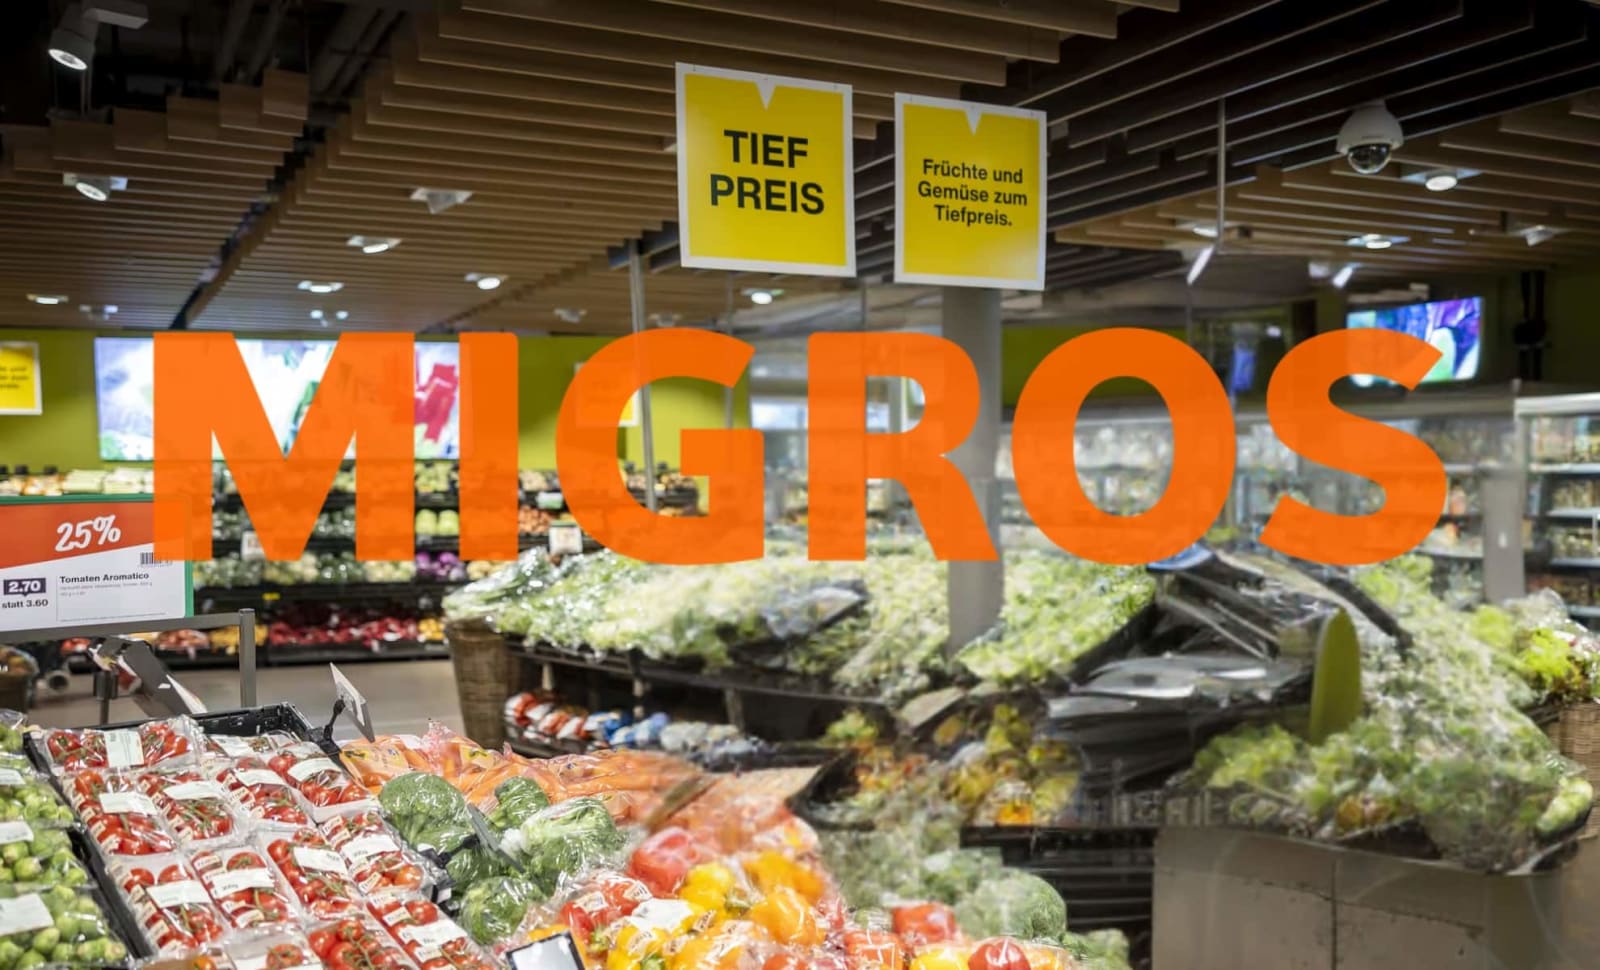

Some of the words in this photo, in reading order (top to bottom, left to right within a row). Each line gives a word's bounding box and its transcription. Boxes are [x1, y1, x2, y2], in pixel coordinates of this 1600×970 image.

[723, 128, 809, 169] TIEF
[922, 158, 988, 181] Früchte
[992, 166, 1024, 184] und
[710, 173, 825, 215] PREIS
[917, 180, 989, 203] Gemüse
[993, 190, 1028, 206] zum
[933, 204, 1013, 227] Tiefpreis.
[55, 514, 121, 552] 25%
[8, 580, 41, 593] 2.70
[59, 575, 101, 584] Tomaten
[102, 572, 150, 582] Aromatico
[26, 599, 49, 608] 3.60
